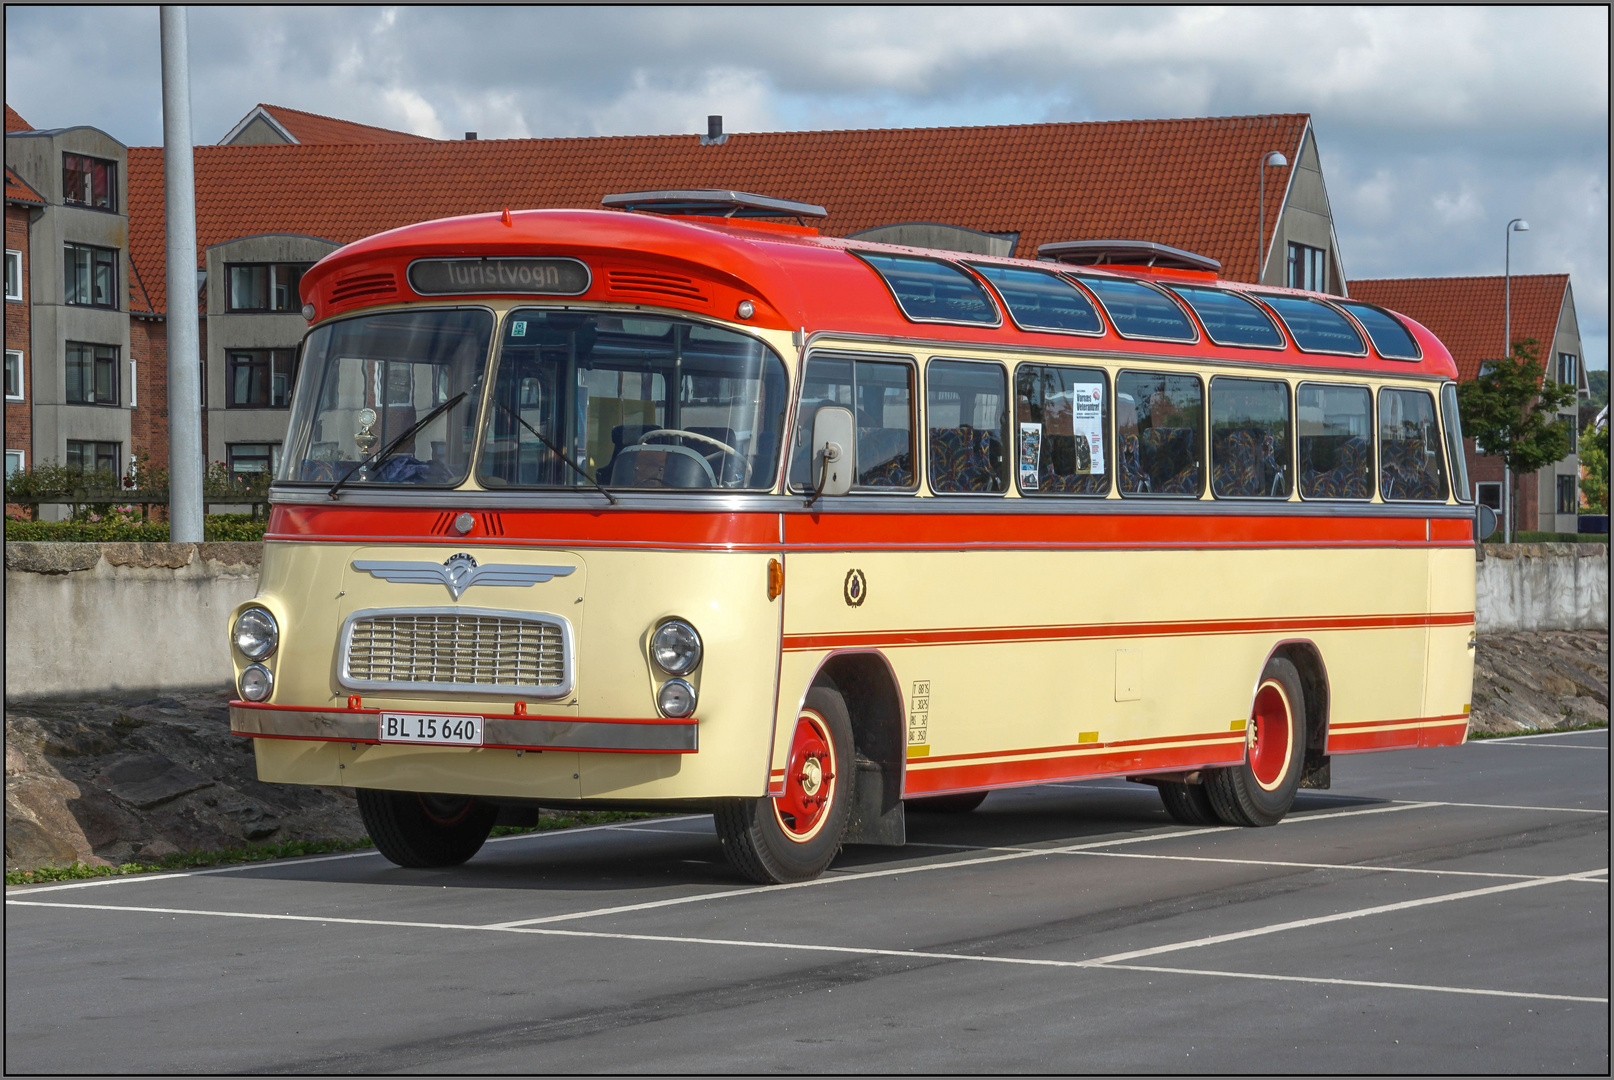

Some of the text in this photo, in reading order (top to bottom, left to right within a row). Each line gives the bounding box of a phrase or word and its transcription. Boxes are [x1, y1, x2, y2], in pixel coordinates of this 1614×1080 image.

[442, 260, 559, 287] Turistvogn
[443, 553, 477, 568] VOLVO
[387, 717, 475, 740] BL 15 640
